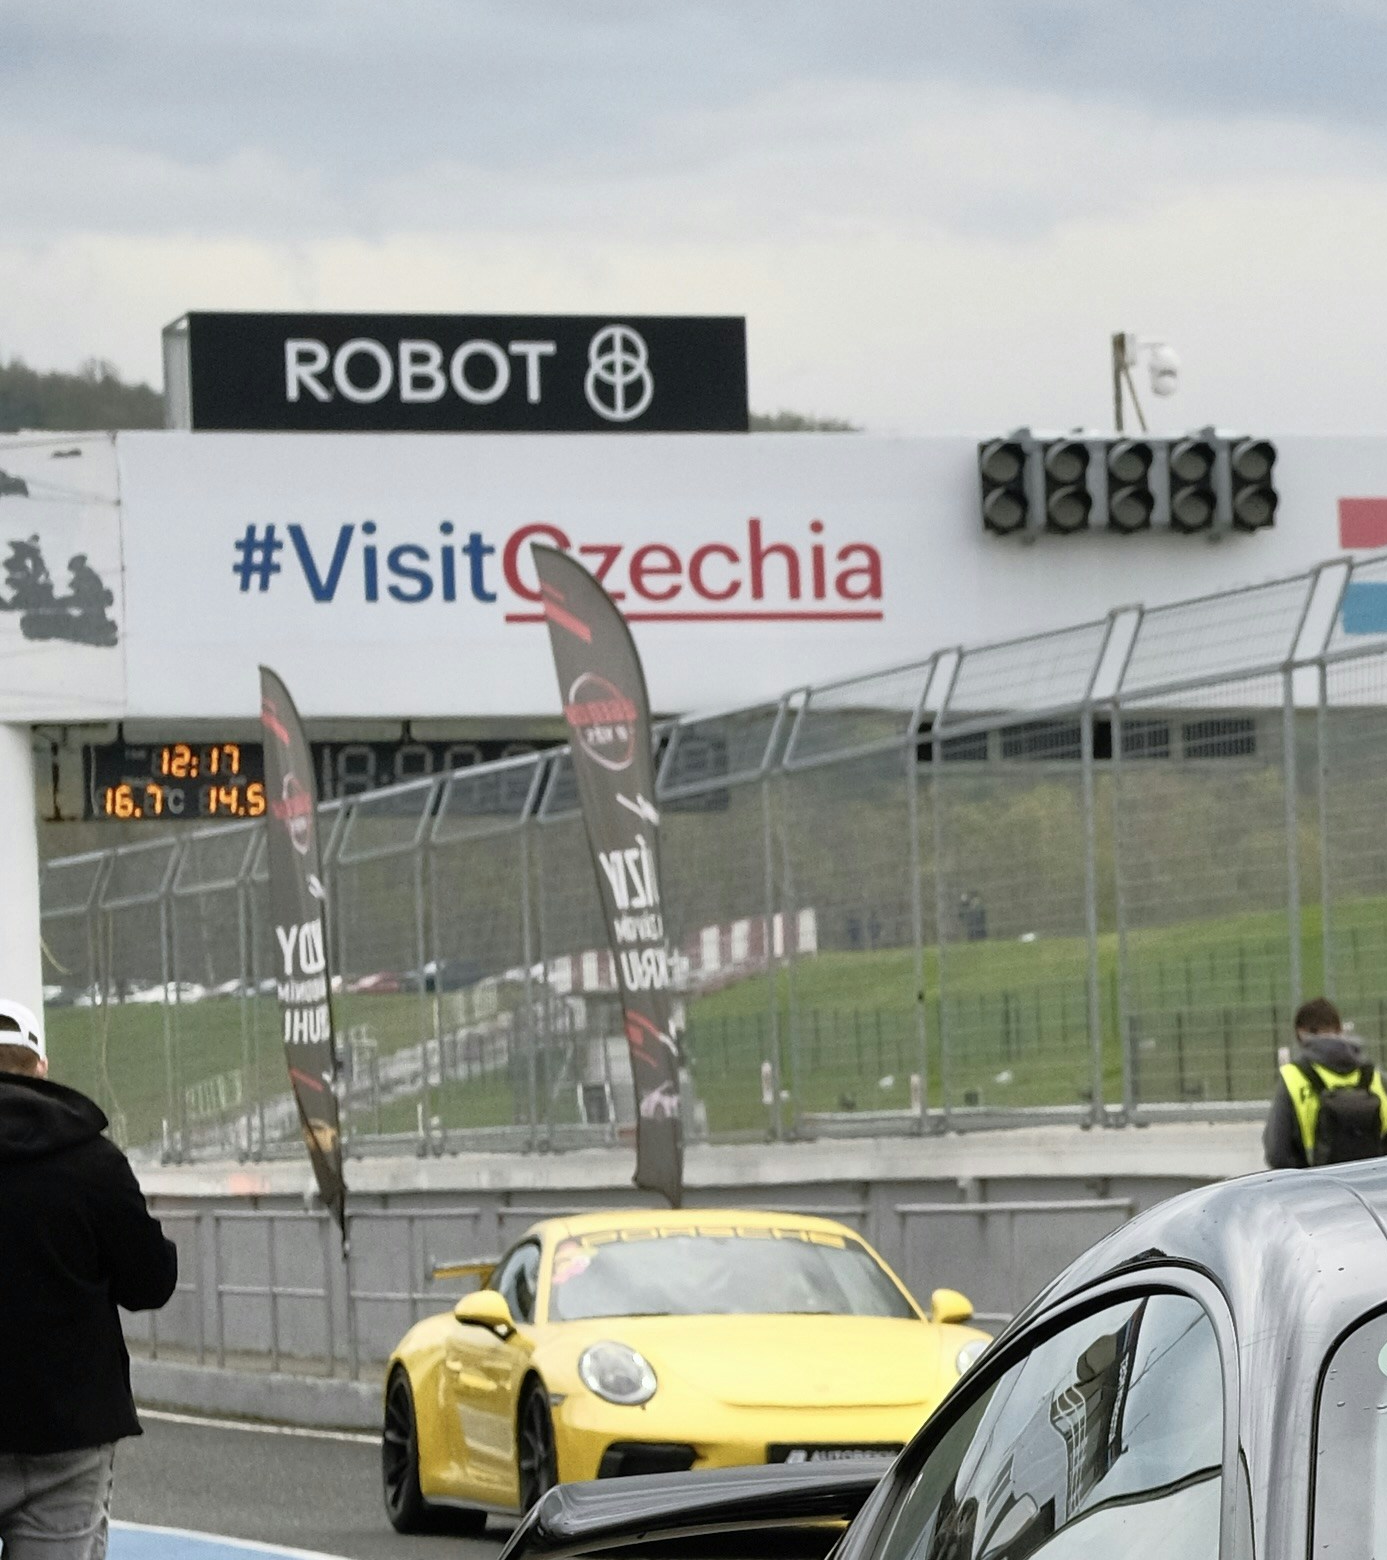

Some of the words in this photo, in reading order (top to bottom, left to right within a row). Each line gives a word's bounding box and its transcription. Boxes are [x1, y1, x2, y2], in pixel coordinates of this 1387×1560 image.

[283, 337, 557, 404] ROBOT
[160, 743, 241, 778] 12:17
[105, 783, 164, 818] 16.7
[208, 782, 266, 817] 14.5
